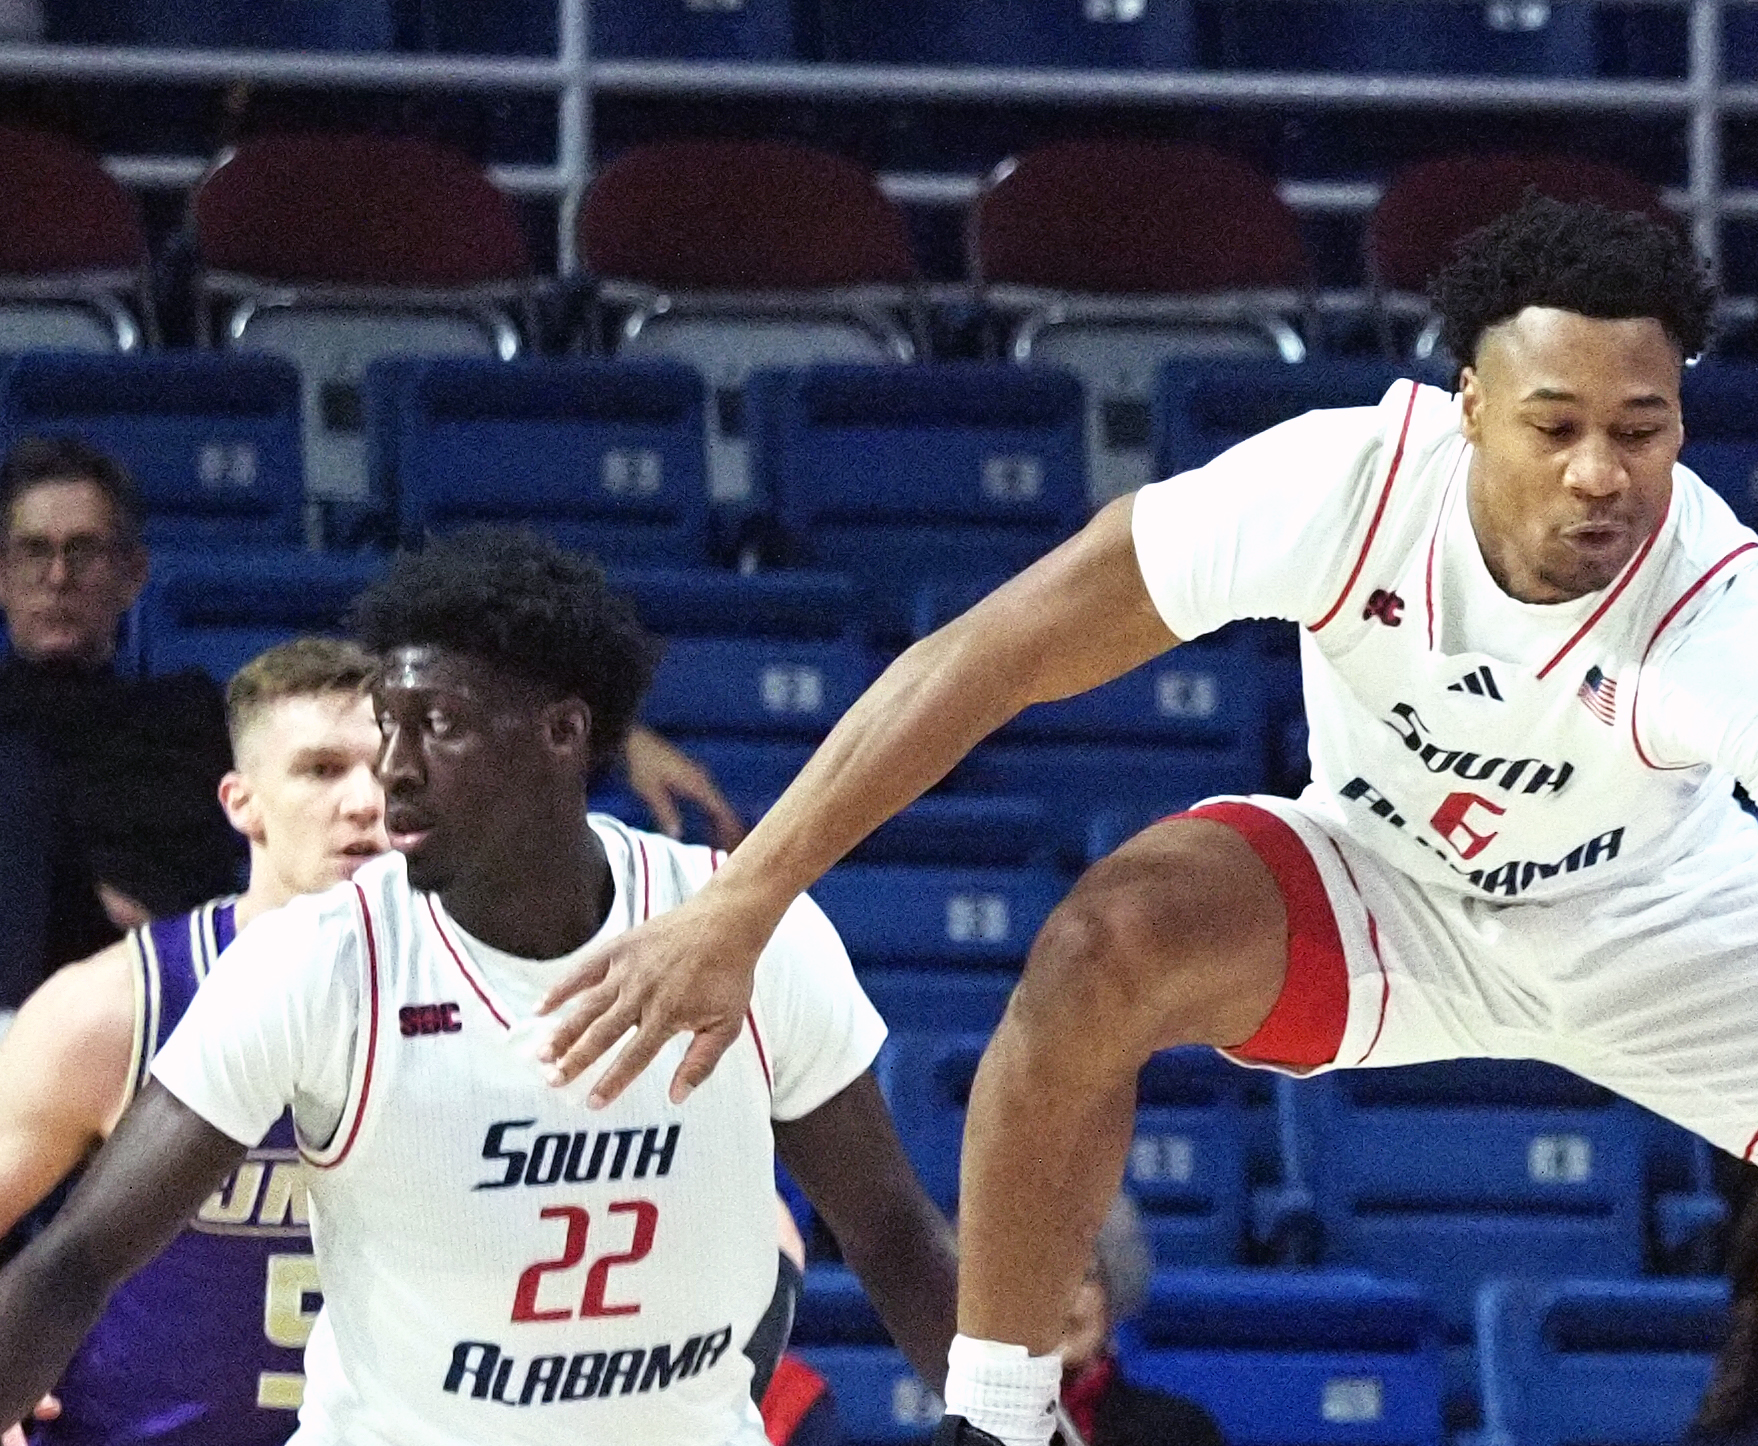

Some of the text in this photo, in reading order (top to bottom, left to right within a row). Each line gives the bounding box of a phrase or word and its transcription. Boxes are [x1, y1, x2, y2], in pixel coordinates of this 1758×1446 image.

[1380, 702, 1575, 794] SOUTH
[1430, 792, 1507, 860] 6
[471, 1117, 682, 1191] SOUTH
[511, 1200, 659, 1323] 22
[257, 1252, 324, 1410] 5
[443, 1323, 732, 1406] ALABAMA
